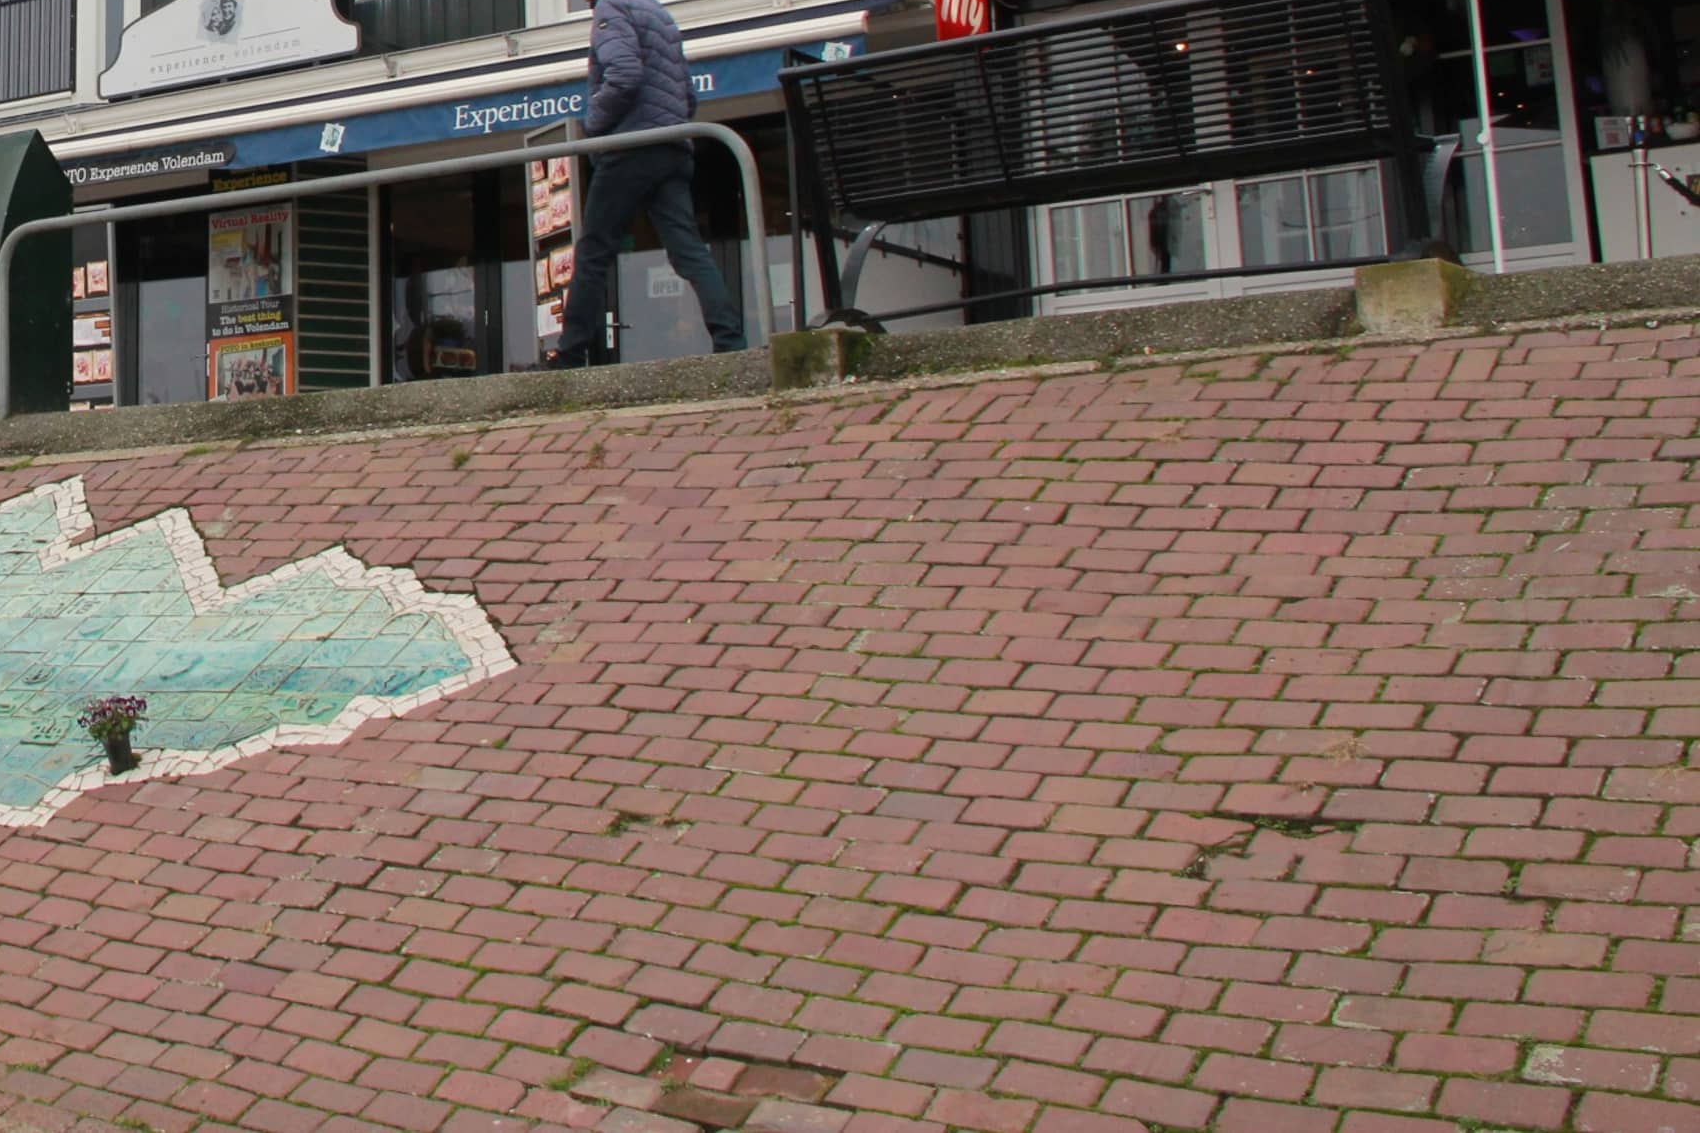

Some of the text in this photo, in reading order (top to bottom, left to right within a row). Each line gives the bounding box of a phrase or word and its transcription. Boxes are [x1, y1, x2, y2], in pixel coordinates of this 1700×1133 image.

[150, 38, 301, 75] experience volendam
[453, 94, 583, 134] Experience
[89, 160, 159, 181] Experience
[161, 151, 225, 170] Volendam
[212, 209, 289, 229] Virtual Reality
[220, 315, 237, 326] The
[245, 321, 289, 334] Volendam
